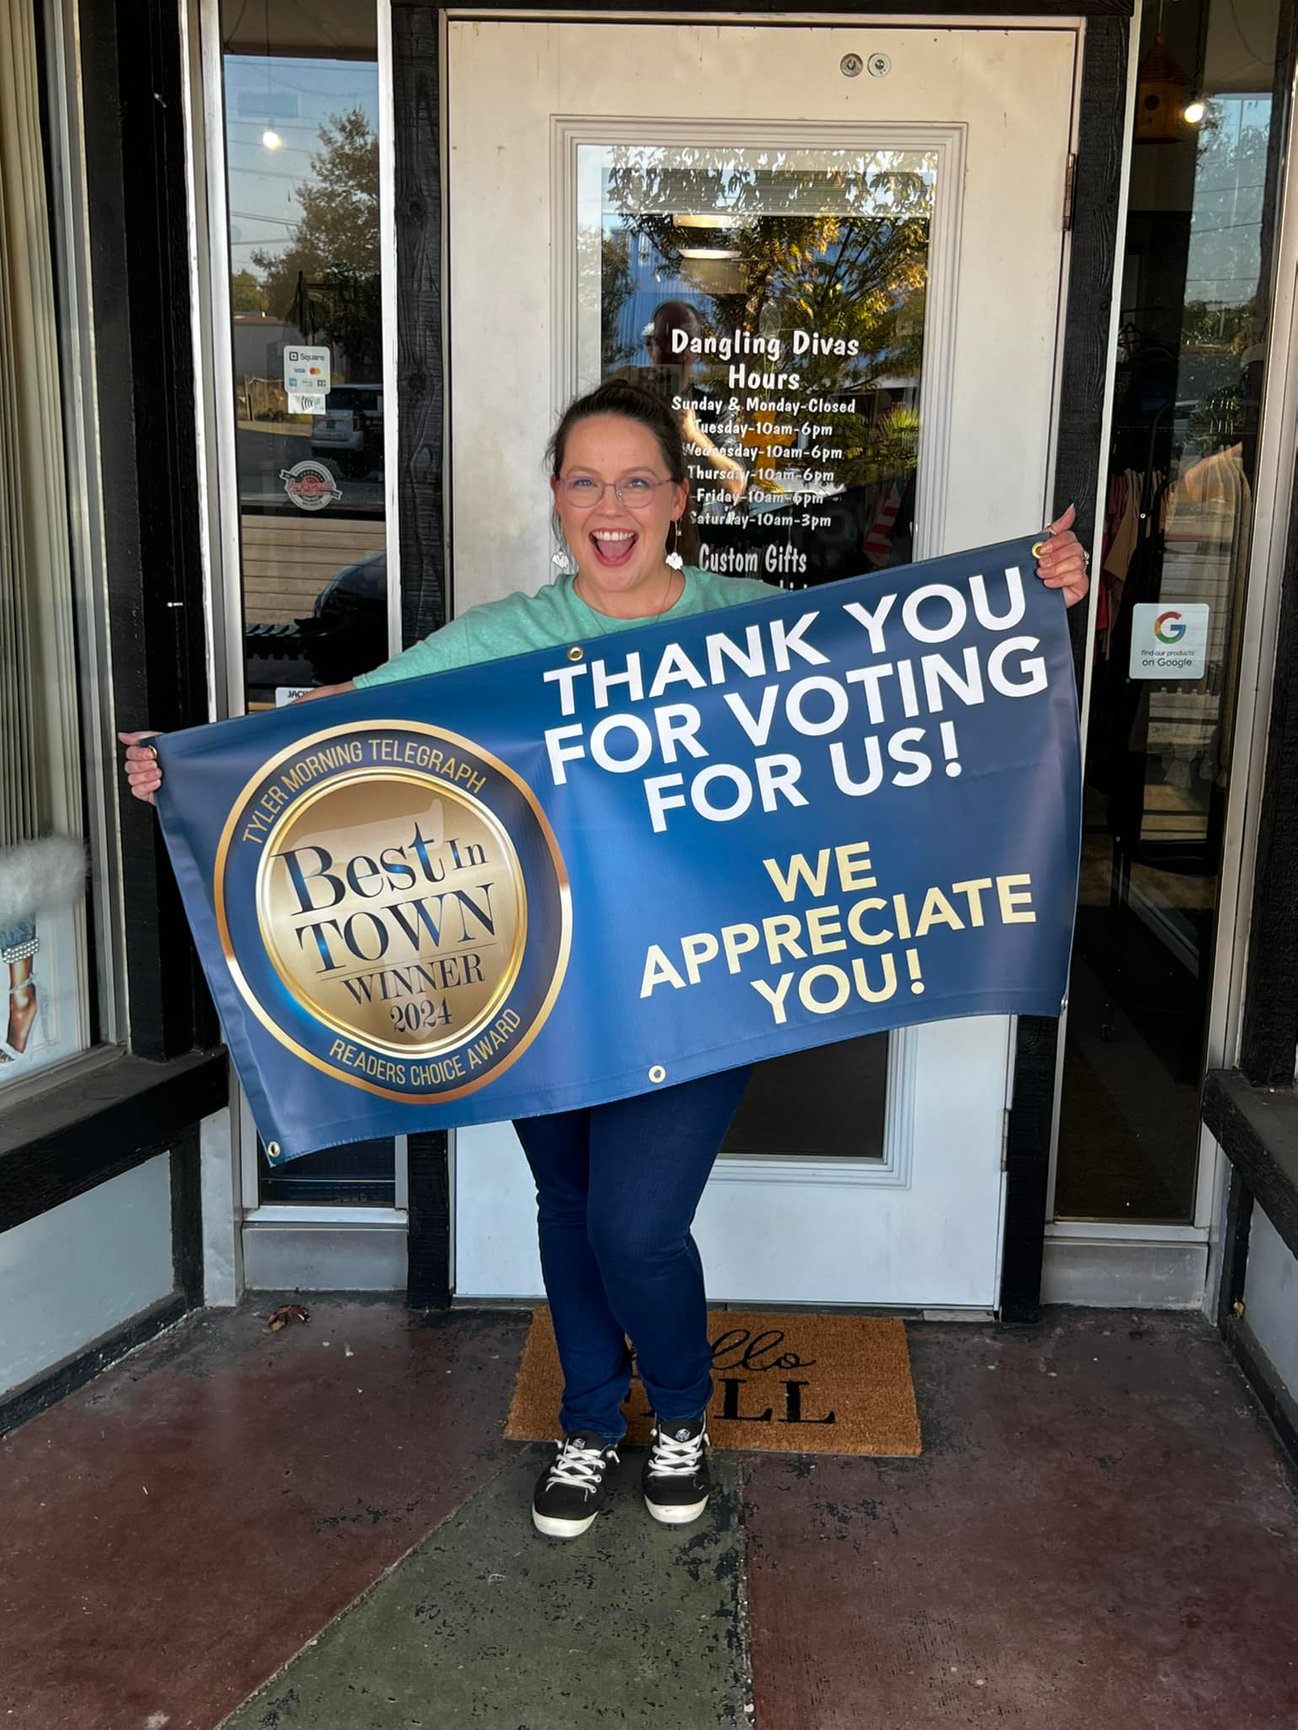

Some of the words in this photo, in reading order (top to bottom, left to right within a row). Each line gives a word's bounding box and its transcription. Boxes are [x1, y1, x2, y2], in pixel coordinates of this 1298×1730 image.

[300, 353, 325, 361] Square
[671, 329, 781, 361] Dangling
[793, 330, 860, 356] Divas
[728, 364, 800, 390] Hours
[671, 397, 722, 415] Sunday
[728, 398, 740, 411] &
[746, 398, 856, 415] Monday-Closed
[695, 419, 833, 439] Tuesday-10am-6pm
[682, 443, 843, 461] Wednesday-10am-6pm
[687, 465, 834, 482] Thursday-10am-6pm
[698, 543, 758, 573] Custom
[765, 543, 807, 573] Gifts
[543, 611, 831, 717] THANK
[843, 566, 1027, 654] YOU
[1142, 659, 1155, 667] on
[1157, 658, 1192, 668] Google
[544, 702, 709, 786] FOR
[724, 636, 1049, 748] VOTING
[243, 786, 288, 845] TYLER
[285, 742, 363, 790] MORNING
[368, 739, 488, 796] TELEGRAPH
[643, 753, 810, 834] FOR
[829, 721, 962, 797] US!
[271, 821, 446, 917] Best
[446, 838, 489, 871] In
[763, 841, 877, 903] WE
[294, 882, 495, 974] TOWN
[639, 873, 1037, 1000] APPRECIATE
[340, 953, 485, 1005] WINNER
[750, 949, 925, 1026] YOU!
[390, 1000, 453, 1034] 2024
[329, 1039, 406, 1086] READERS
[410, 1063, 466, 1087] CHOICE
[468, 1007, 522, 1069] AWARD
[711, 1329, 818, 1371] llo
